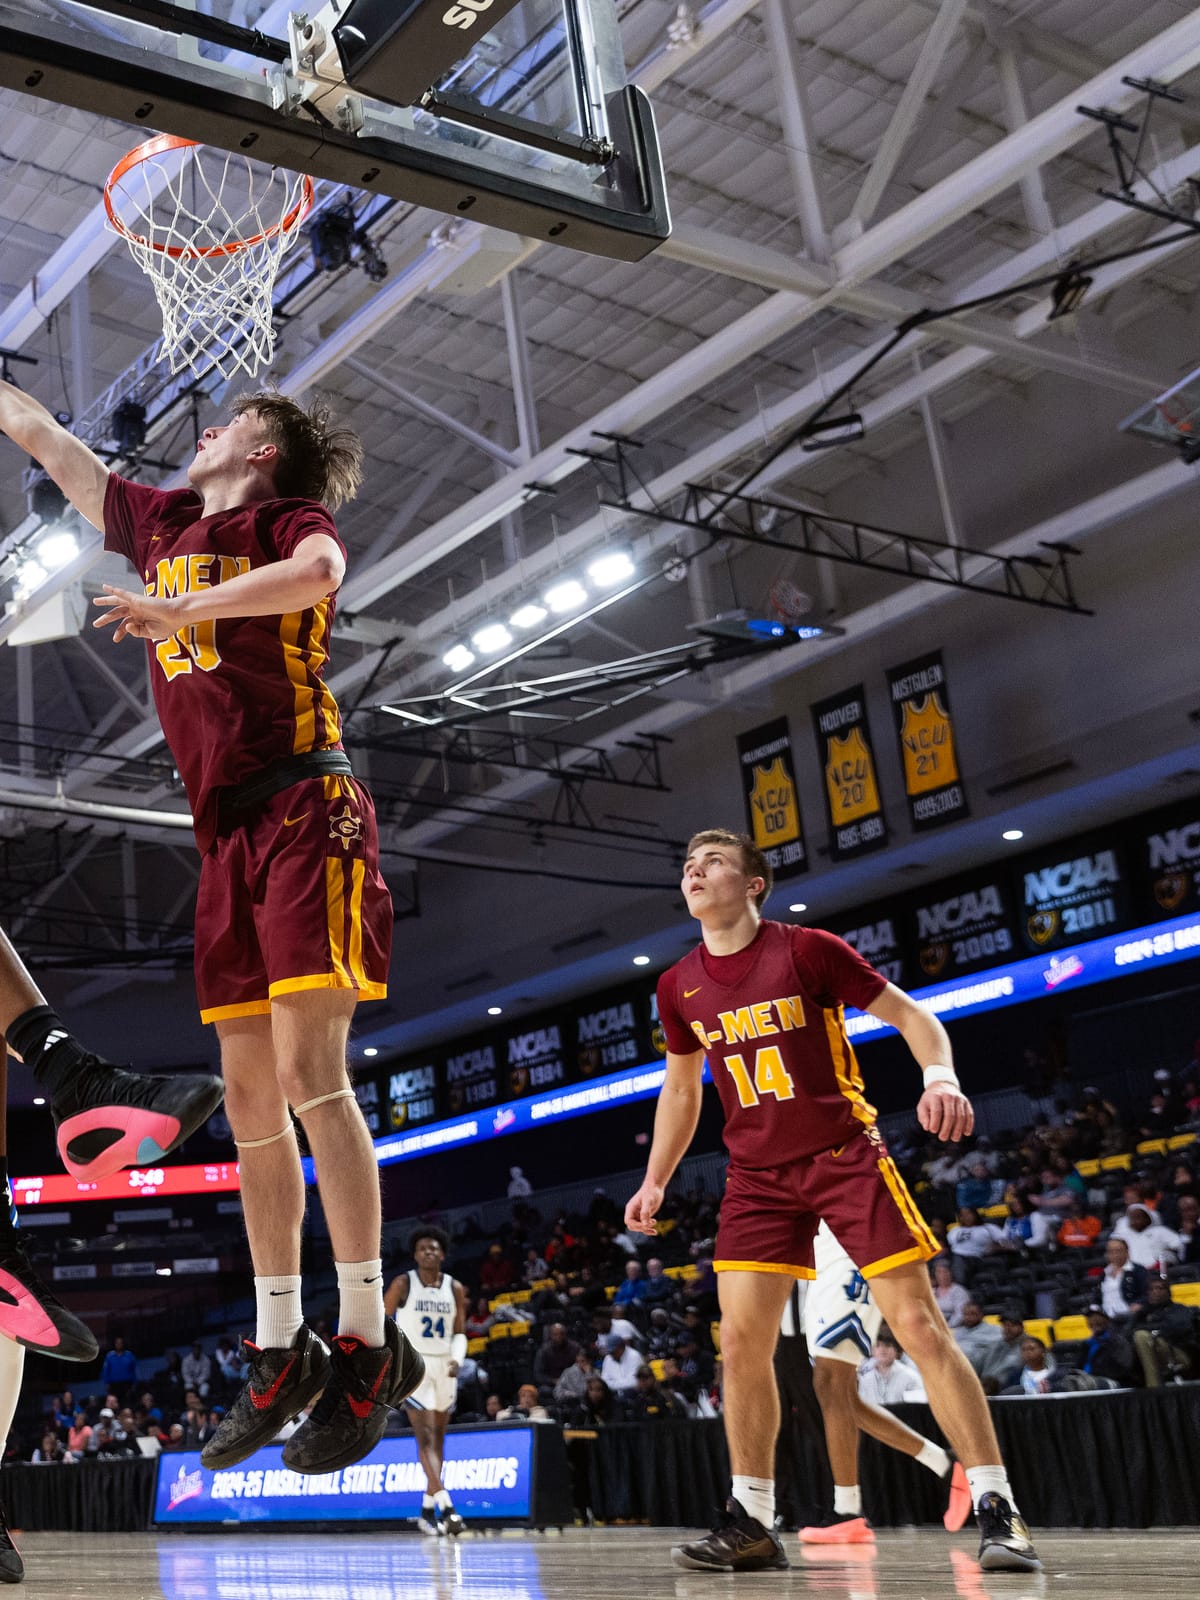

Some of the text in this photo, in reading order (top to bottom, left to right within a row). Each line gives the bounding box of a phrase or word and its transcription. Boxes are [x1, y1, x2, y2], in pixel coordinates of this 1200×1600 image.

[819, 701, 861, 733] HOOVER
[904, 724, 949, 755] VCU
[831, 758, 868, 787] VCU
[916, 751, 940, 776] 21
[754, 785, 792, 813] VCU
[840, 783, 866, 809] 20
[1023, 850, 1119, 907] NCAA
[916, 884, 1004, 939] NCAA
[1061, 899, 1116, 935] 2011
[951, 927, 1012, 964] 2009
[577, 1002, 635, 1043] NCAA
[507, 1025, 561, 1064] NCAA
[446, 1045, 496, 1082] NCAA
[723, 1045, 796, 1109] 14
[389, 1065, 435, 1100] NCAA
[421, 1315, 446, 1339] 24
[211, 1471, 264, 1499] 2024-25
[341, 1463, 386, 1495] STATE
